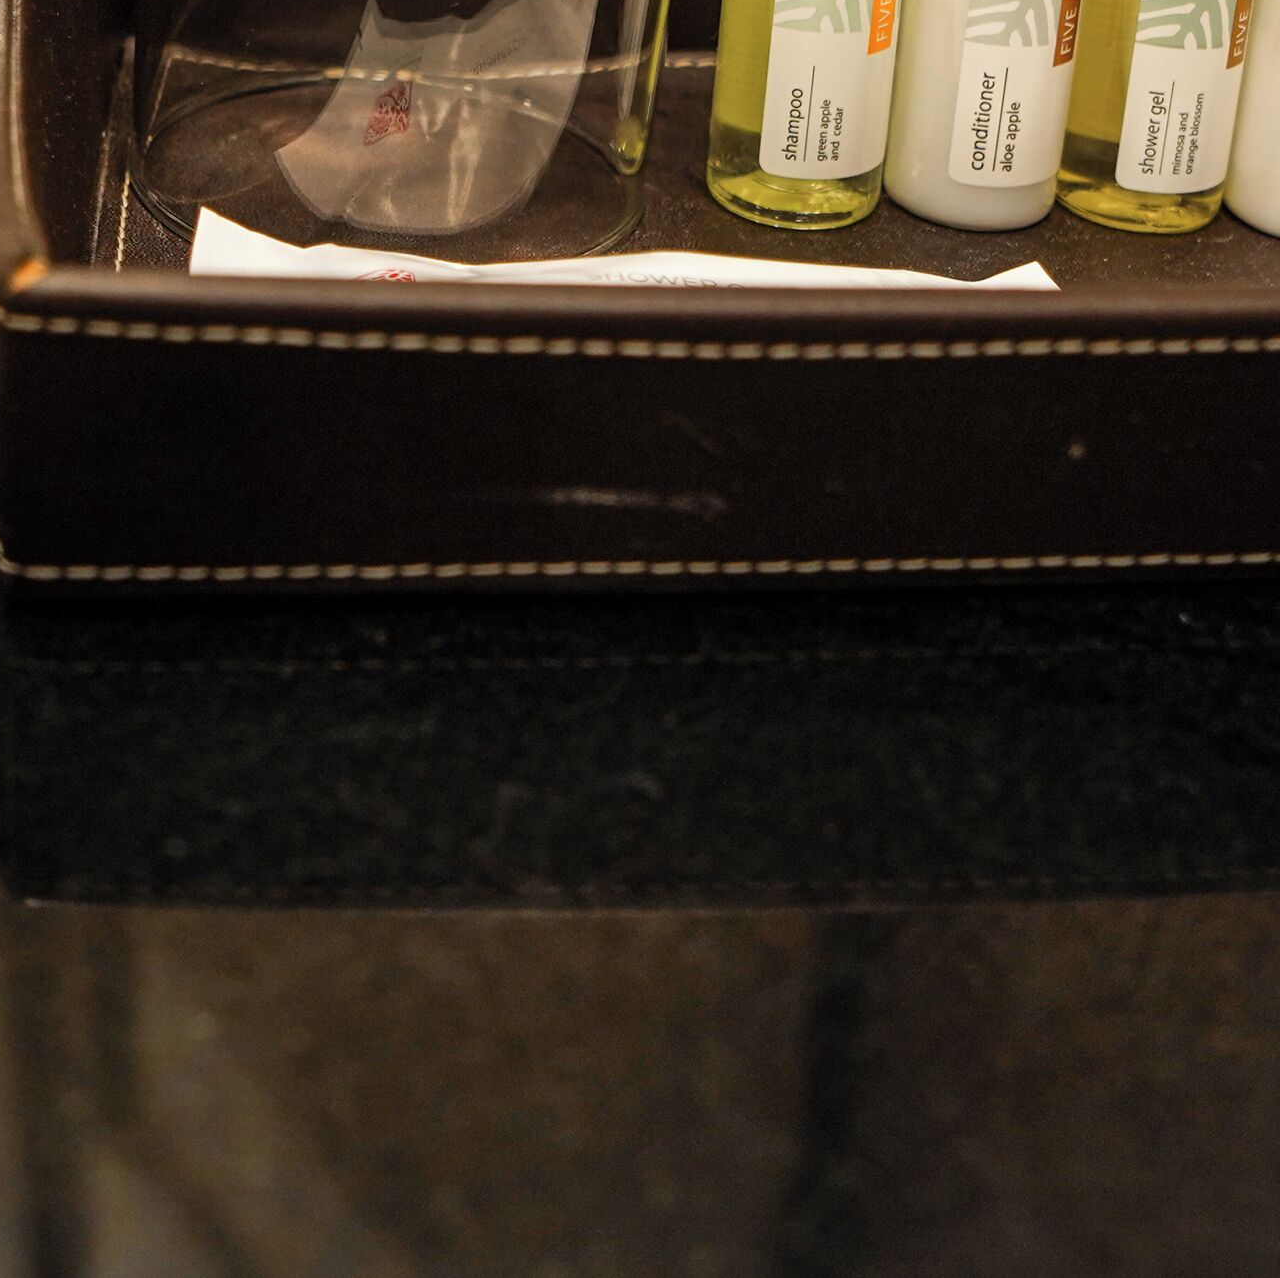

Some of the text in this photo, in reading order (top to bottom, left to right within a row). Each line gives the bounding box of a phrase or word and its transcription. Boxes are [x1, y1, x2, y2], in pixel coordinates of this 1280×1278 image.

[1060, 6, 1077, 55] FIVE
[1233, 9, 1249, 58] FIVE
[781, 88, 805, 162] shampoo
[817, 99, 832, 162] green apple
[830, 107, 844, 161] and cedar
[971, 72, 996, 171] conditioner
[1000, 102, 1021, 172] aloe apple
[1138, 91, 1167, 175] shower gel
[1171, 112, 1189, 175] mimosa and
[1185, 92, 1204, 175] orange blossom
